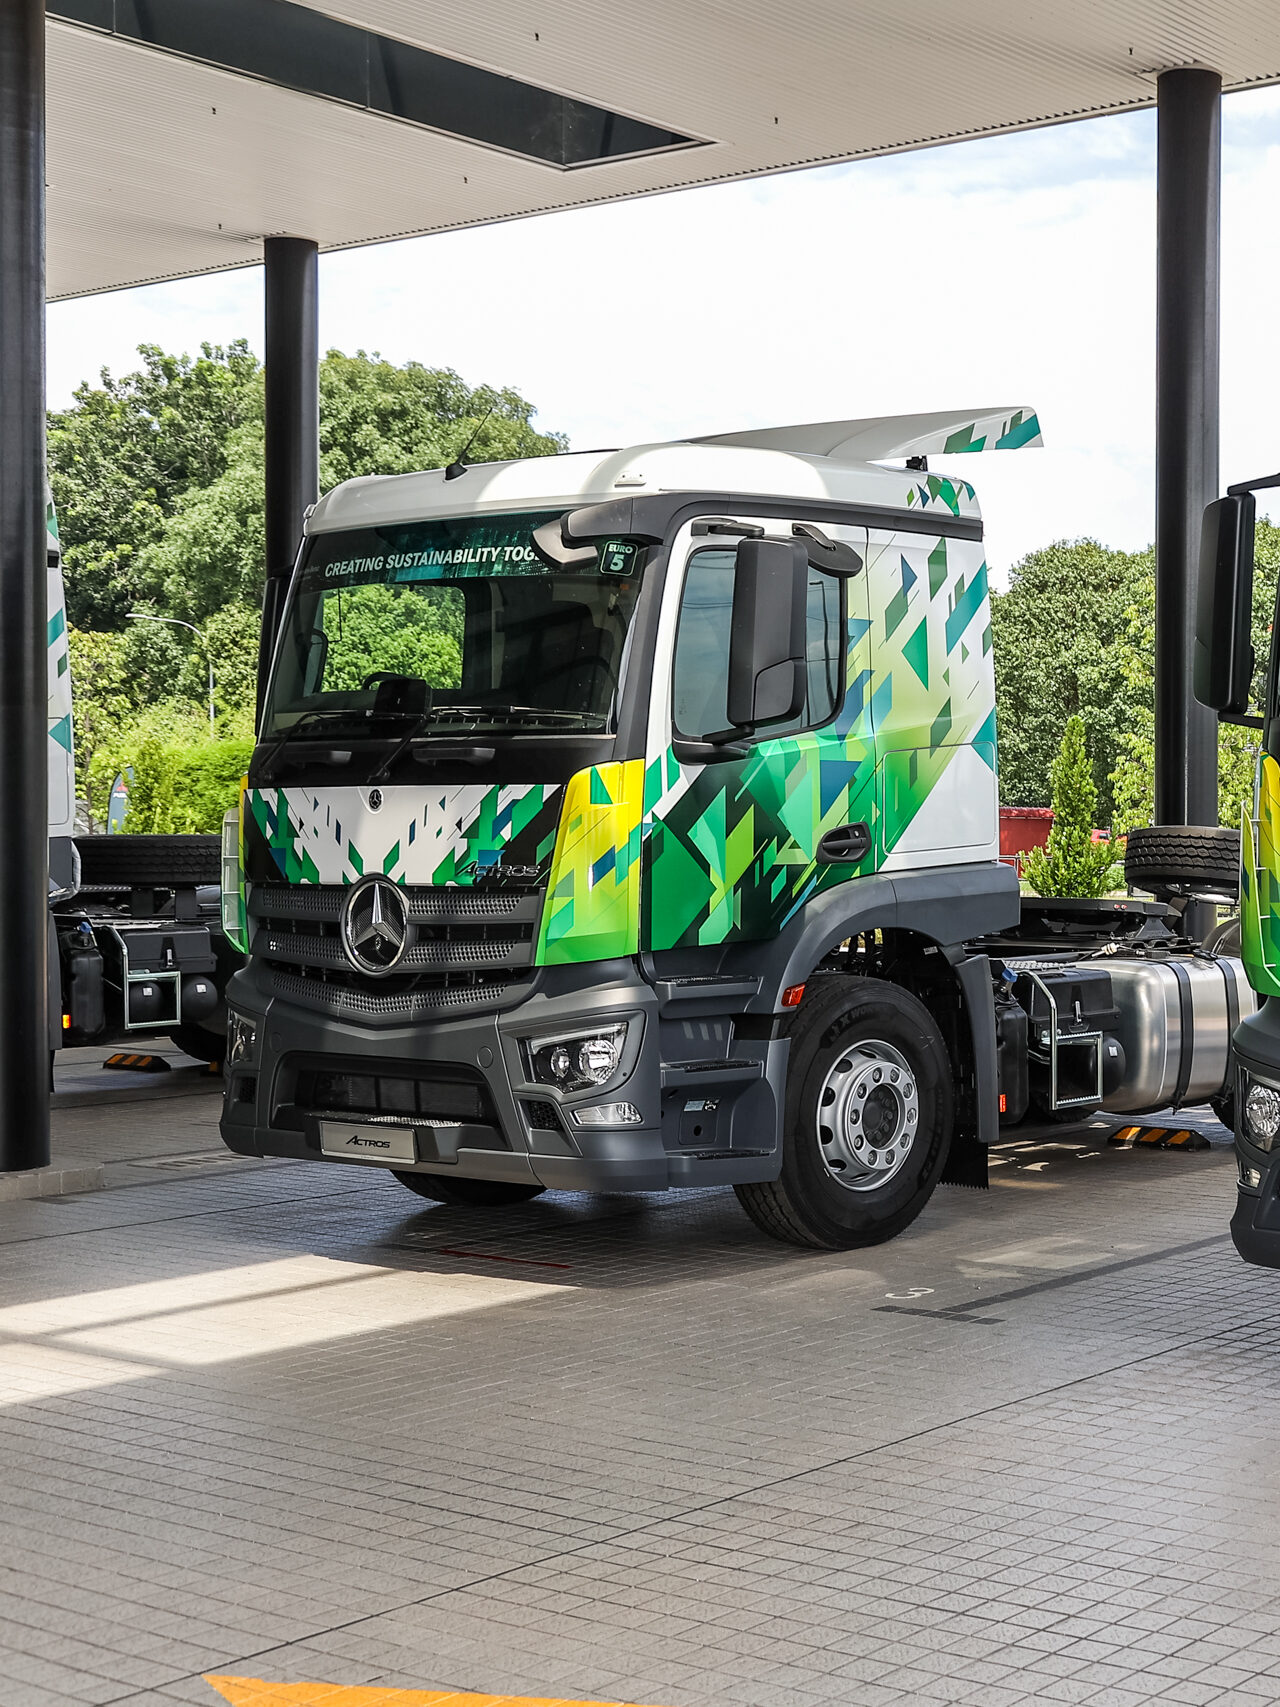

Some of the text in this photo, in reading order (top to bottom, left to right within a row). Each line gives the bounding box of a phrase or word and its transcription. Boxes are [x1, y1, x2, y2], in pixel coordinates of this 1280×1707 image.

[608, 543, 634, 554] EURO
[324, 556, 383, 578] CREATING
[386, 547, 500, 570] SUSTAINABILITY
[504, 546, 540, 562] TOG
[610, 553, 625, 571] 5
[455, 860, 541, 879] ACTROS
[345, 1135, 391, 1149] ACTROS
